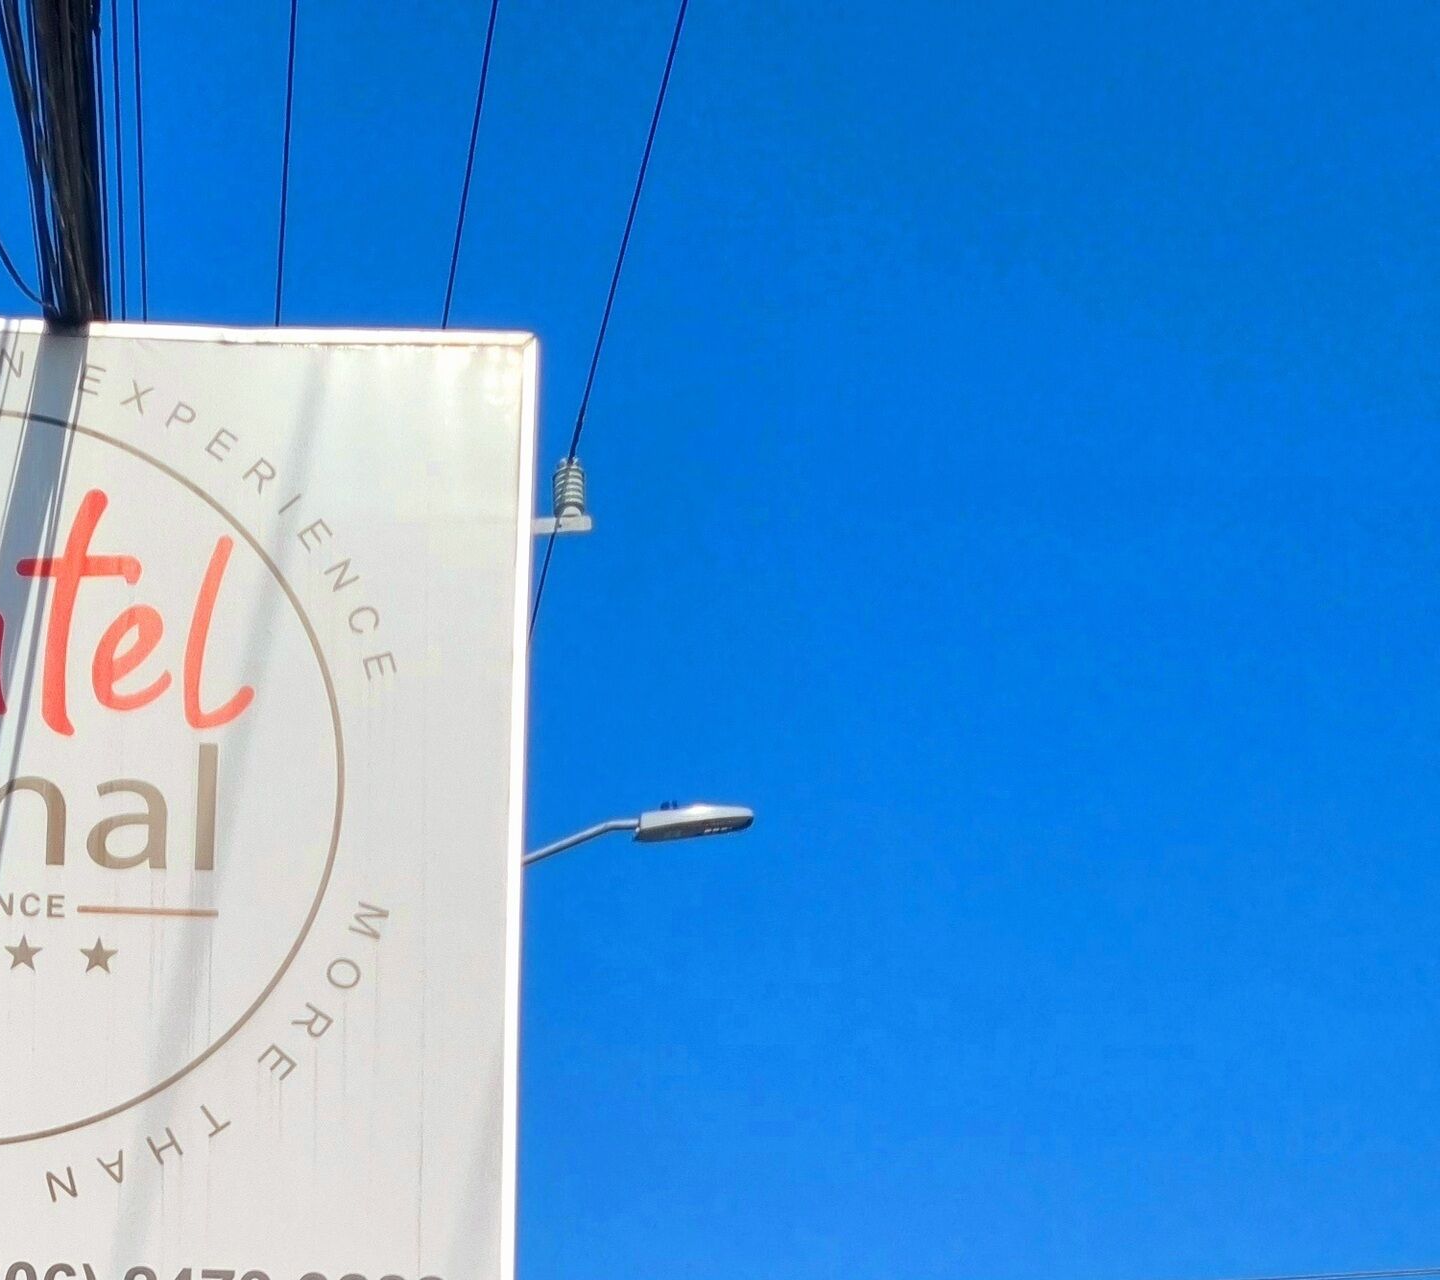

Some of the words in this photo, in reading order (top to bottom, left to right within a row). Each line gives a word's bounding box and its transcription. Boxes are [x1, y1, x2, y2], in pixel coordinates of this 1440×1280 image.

[79, 361, 398, 681] EXPERIENCE
[257, 901, 389, 1082] MORE
[46, 1103, 231, 1205] THAN
